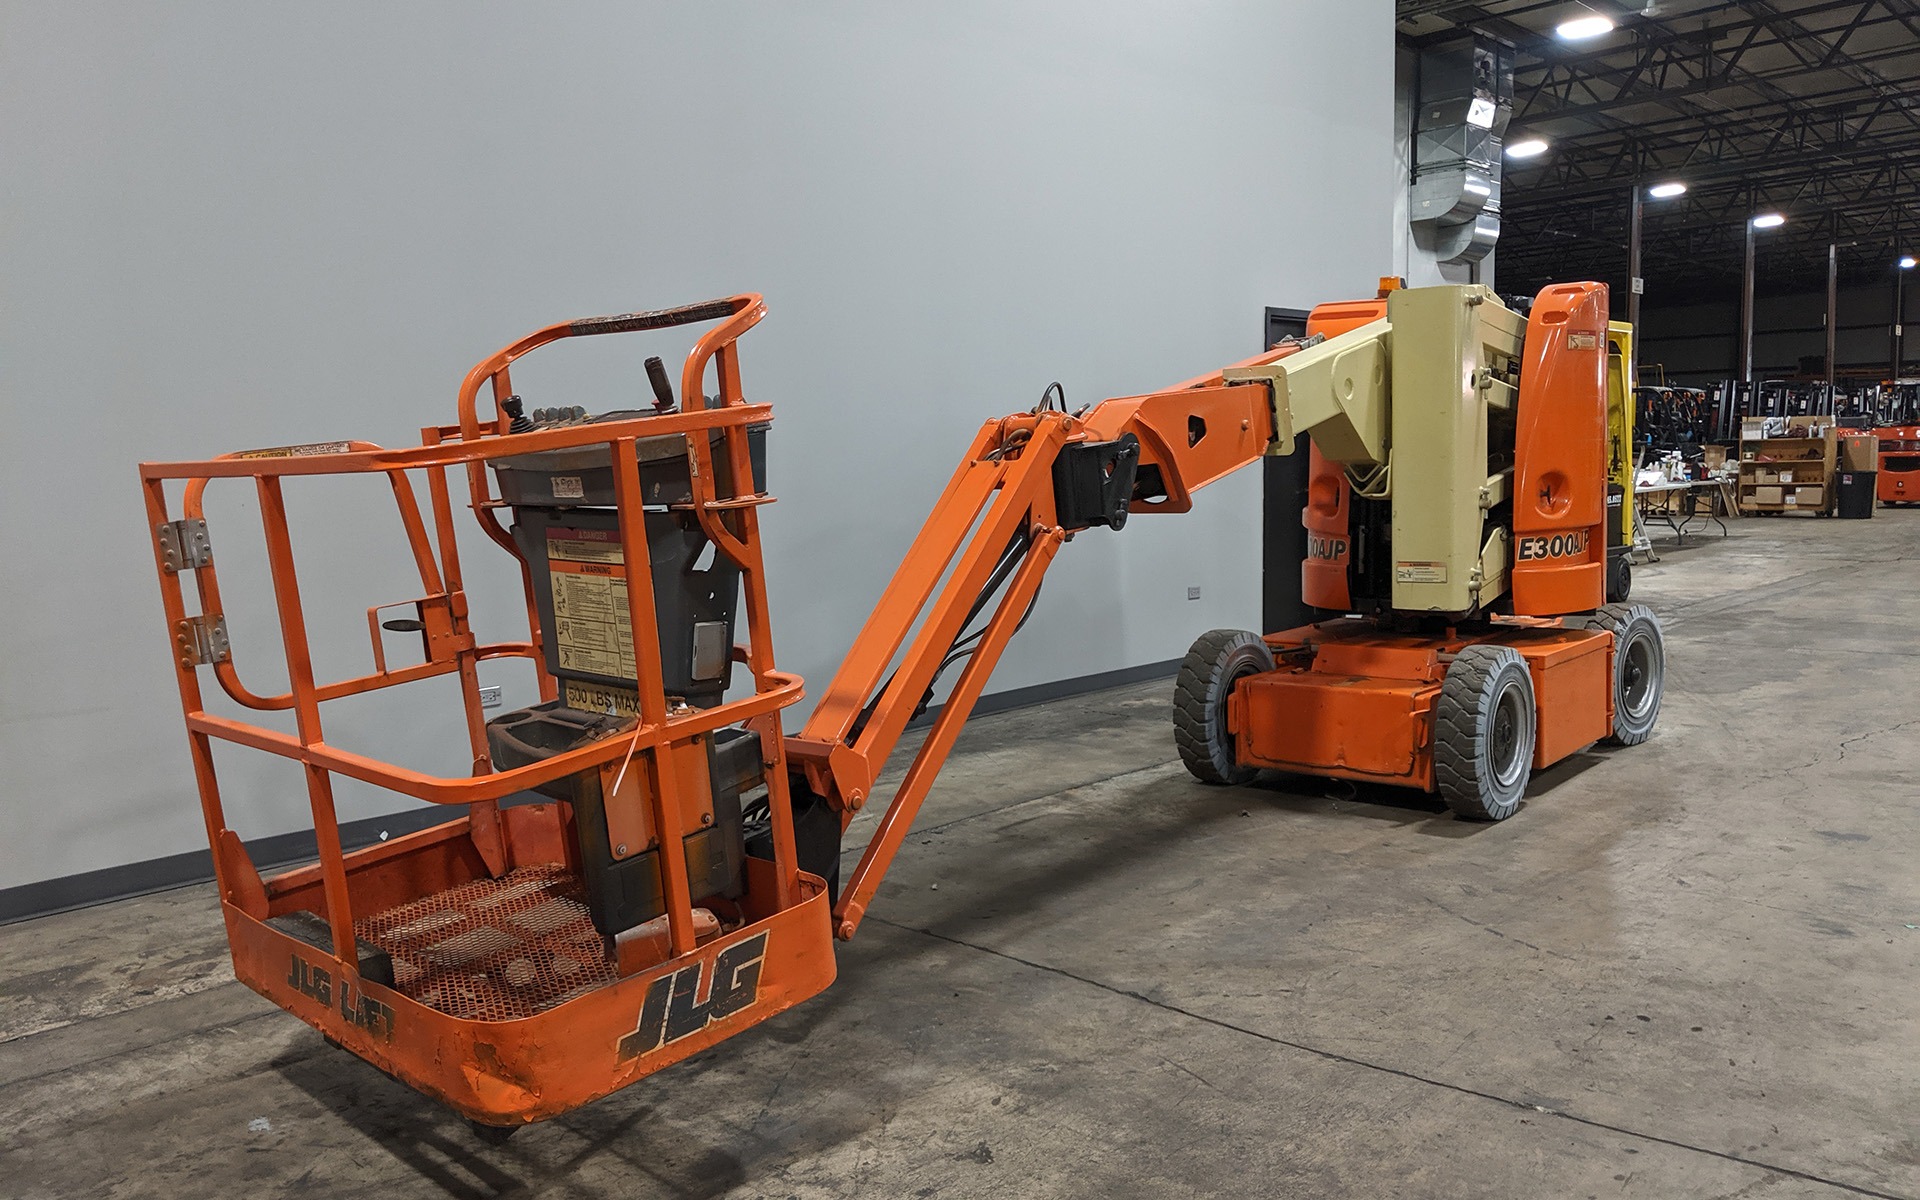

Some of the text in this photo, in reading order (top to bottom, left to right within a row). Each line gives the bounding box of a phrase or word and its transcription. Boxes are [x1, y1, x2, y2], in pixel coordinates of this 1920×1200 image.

[584, 531, 608, 540] DANGER
[1518, 529, 1589, 561] E300AJP
[586, 565, 612, 575] WARNING
[568, 687, 587, 703] 500
[614, 694, 640, 713] MAX
[287, 953, 332, 1009] JLG
[615, 928, 770, 1068] JLG
